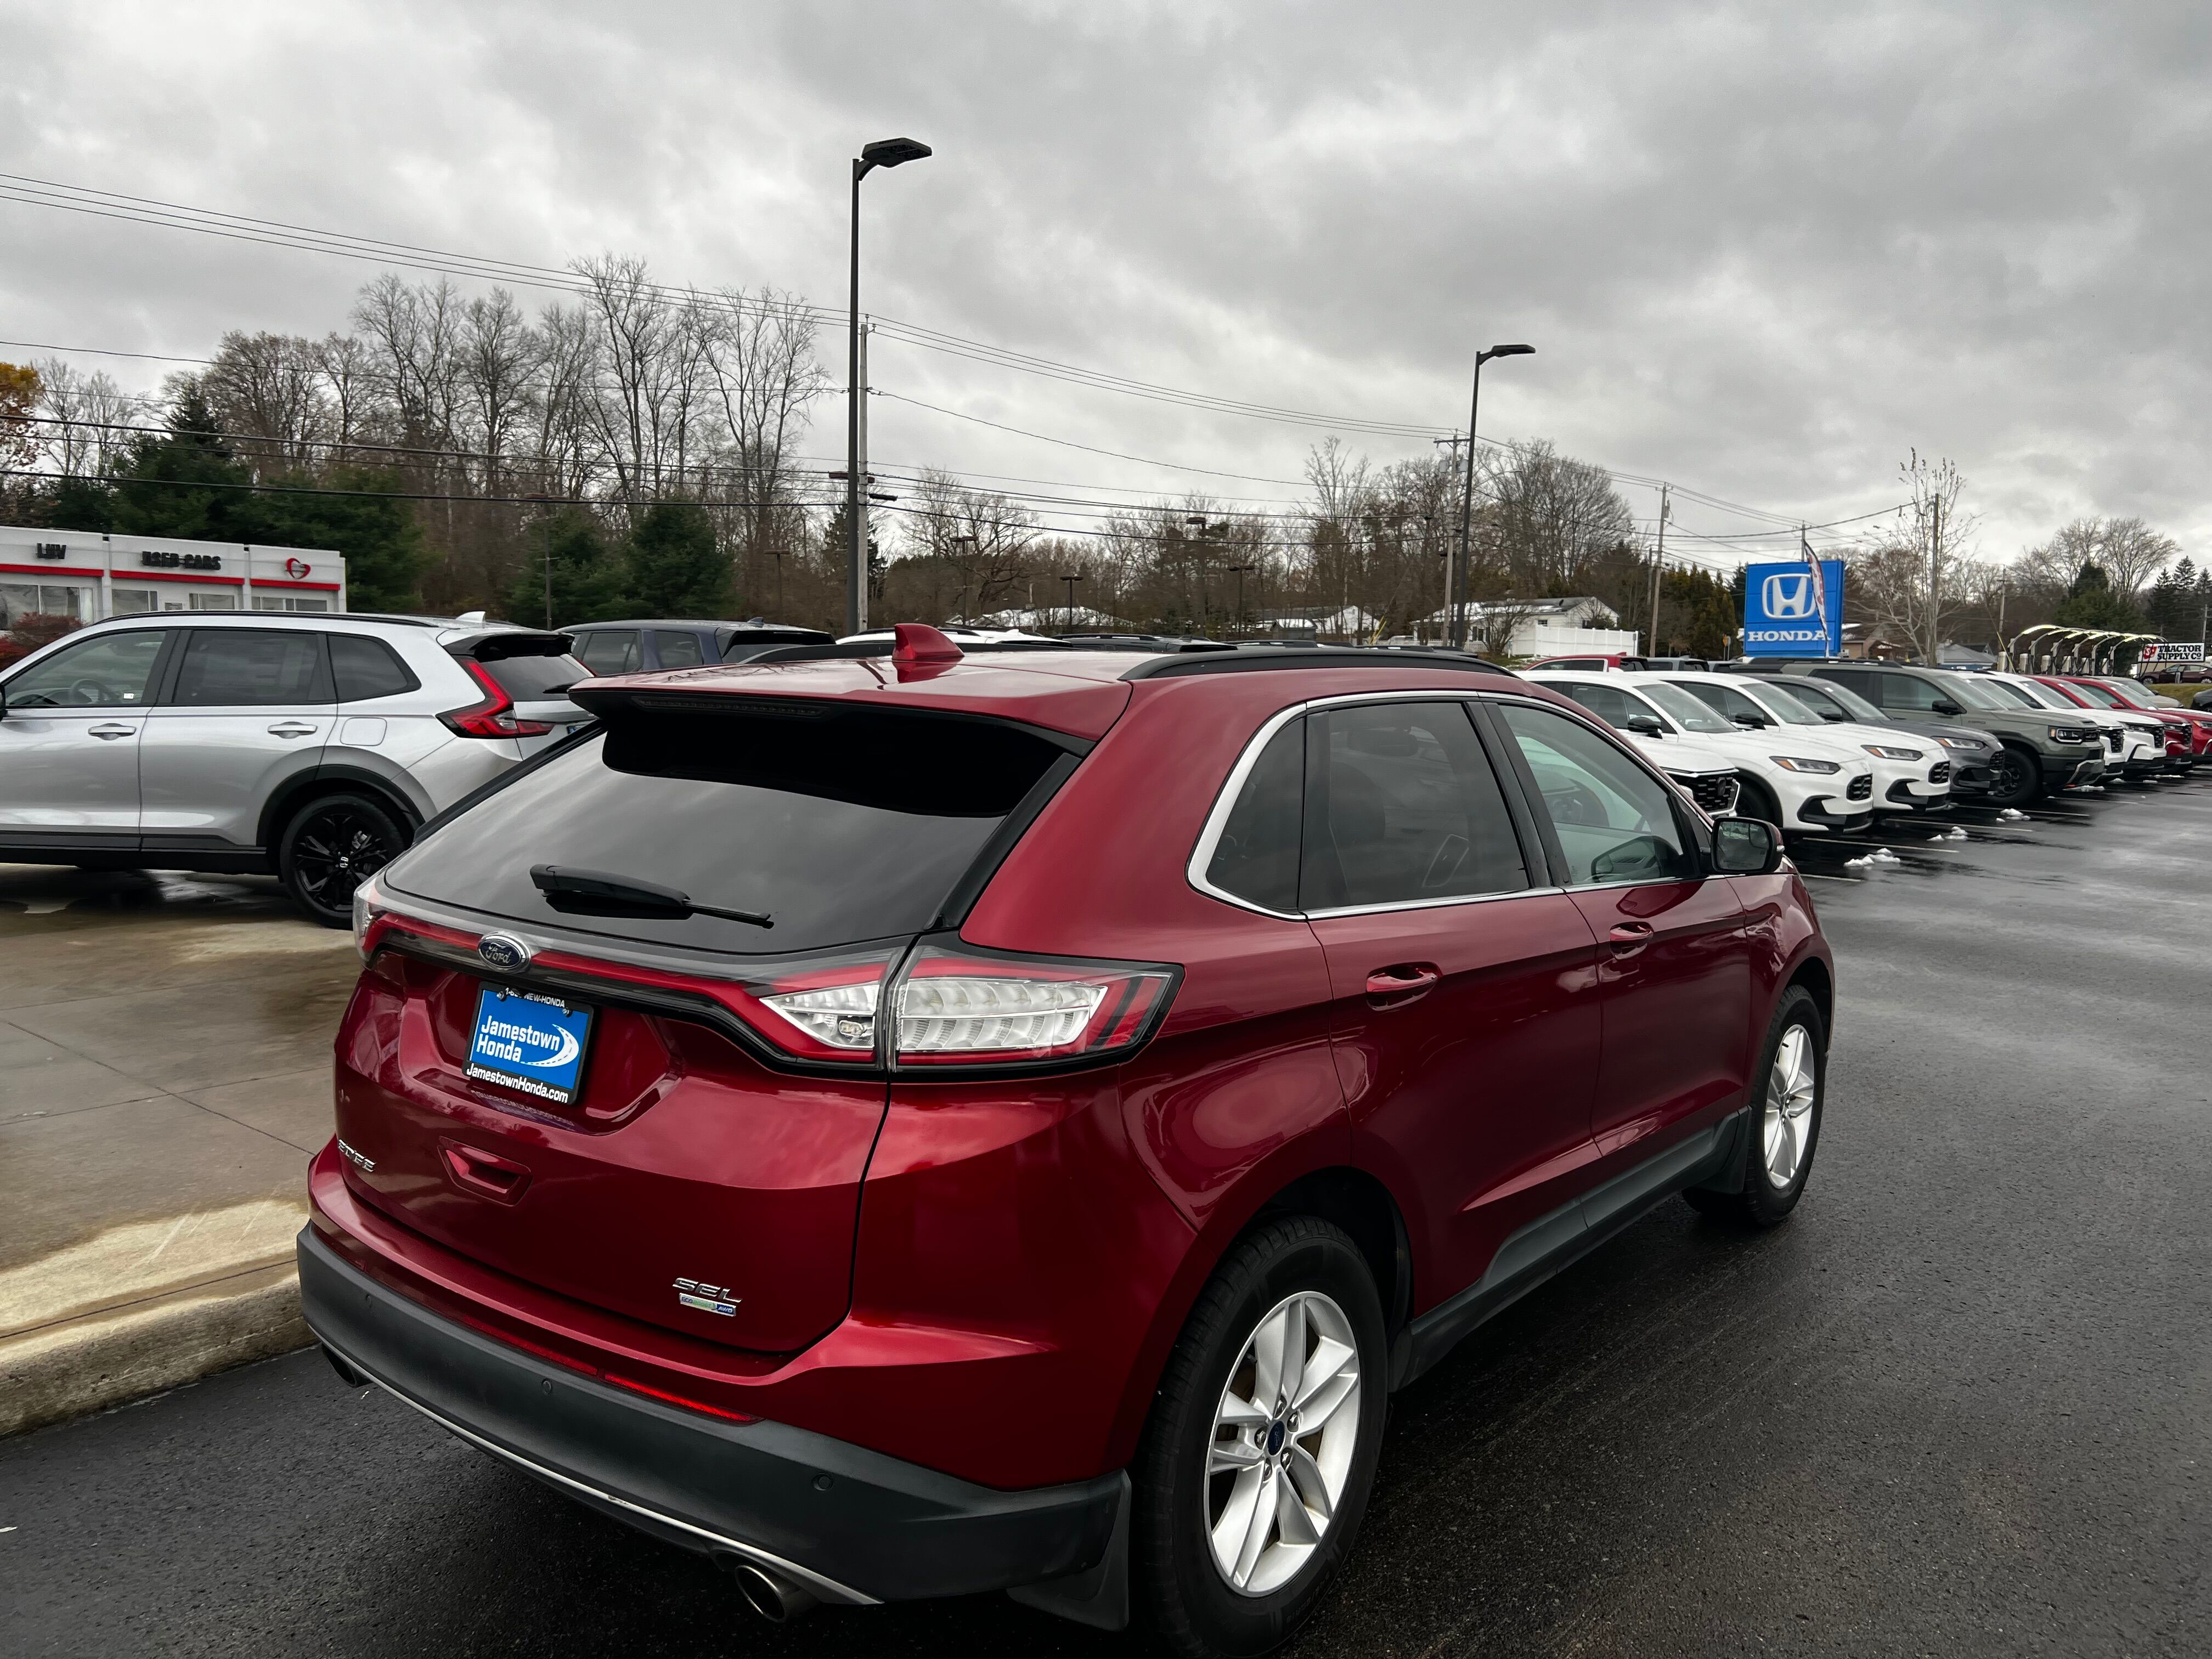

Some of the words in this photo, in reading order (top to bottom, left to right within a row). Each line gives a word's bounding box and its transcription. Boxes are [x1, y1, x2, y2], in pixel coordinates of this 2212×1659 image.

[1747, 630, 1831, 641] HONDA
[486, 942, 512, 964] Ford
[481, 1015, 561, 1052] Jamestown
[476, 1034, 522, 1063] Honda
[466, 1063, 568, 1103] JamestownHonda.com
[672, 1277, 742, 1303] SEL
